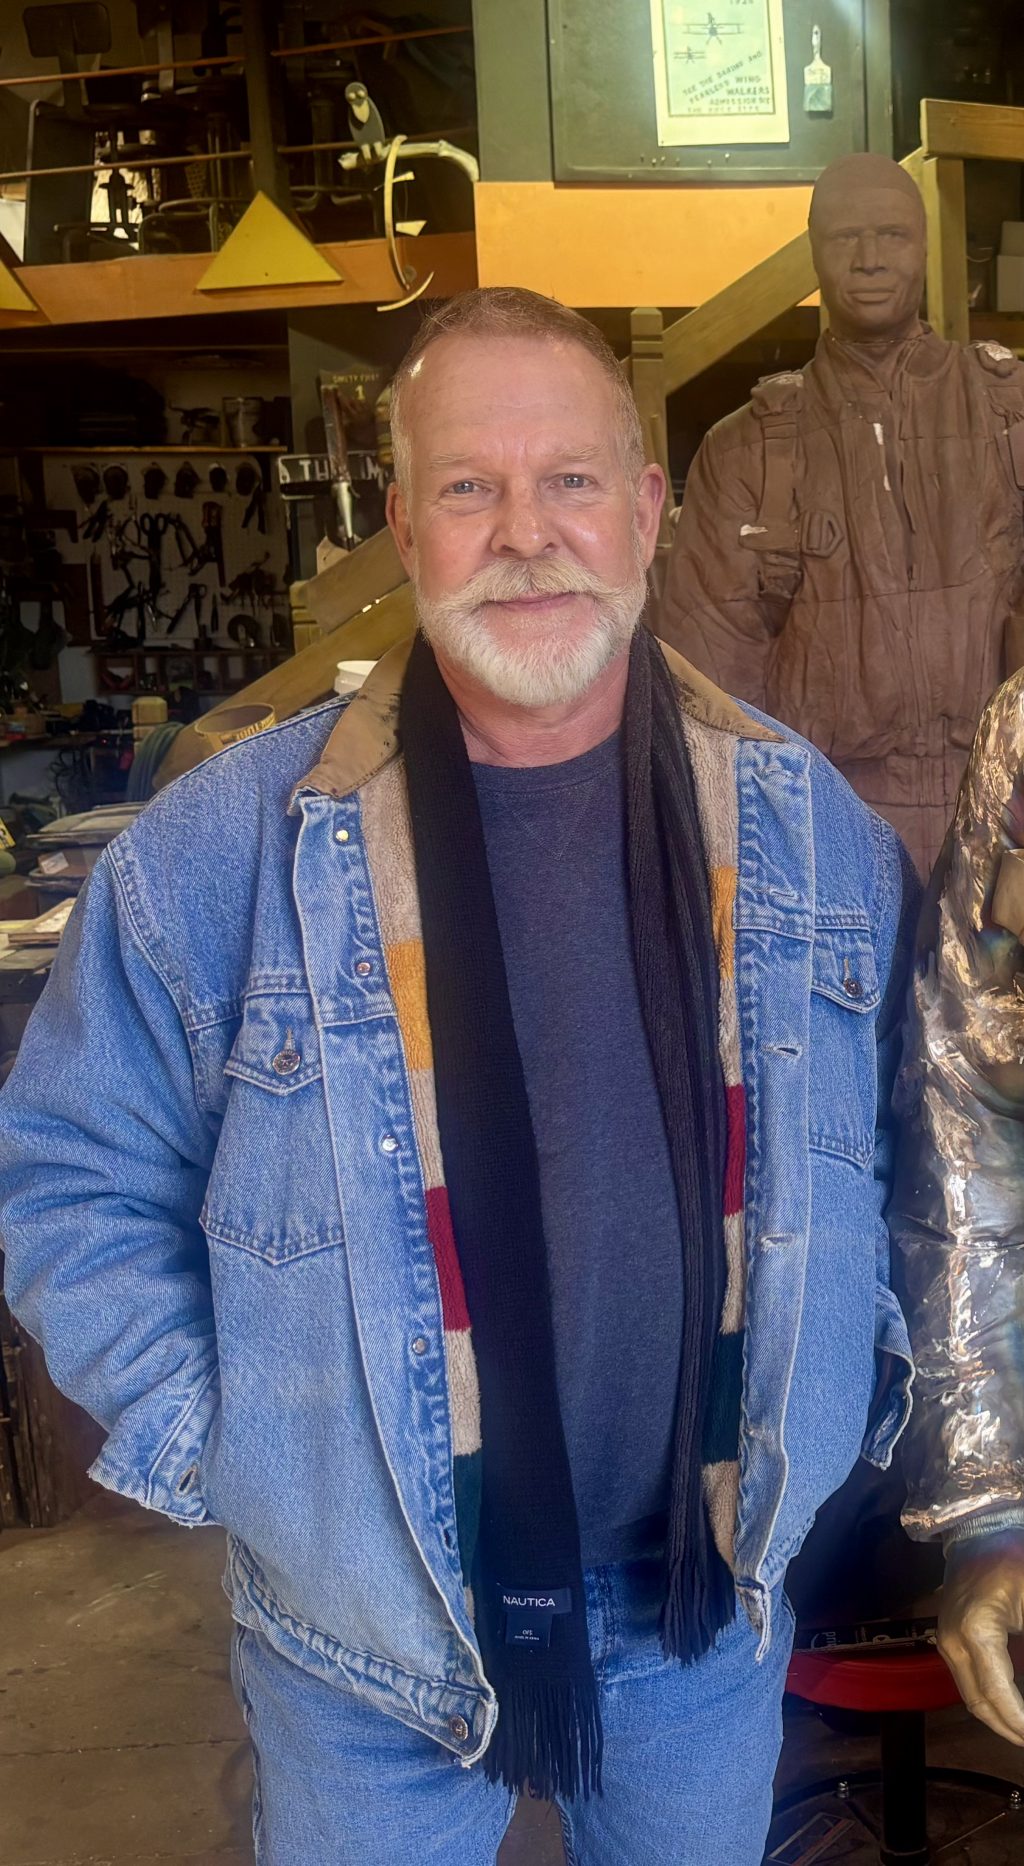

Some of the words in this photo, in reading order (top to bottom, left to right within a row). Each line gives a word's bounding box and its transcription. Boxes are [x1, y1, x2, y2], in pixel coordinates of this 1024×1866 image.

[726, 86, 770, 96] WALKERS
[355, 385, 366, 401] 1
[502, 1595, 556, 1608] NAUTICA
